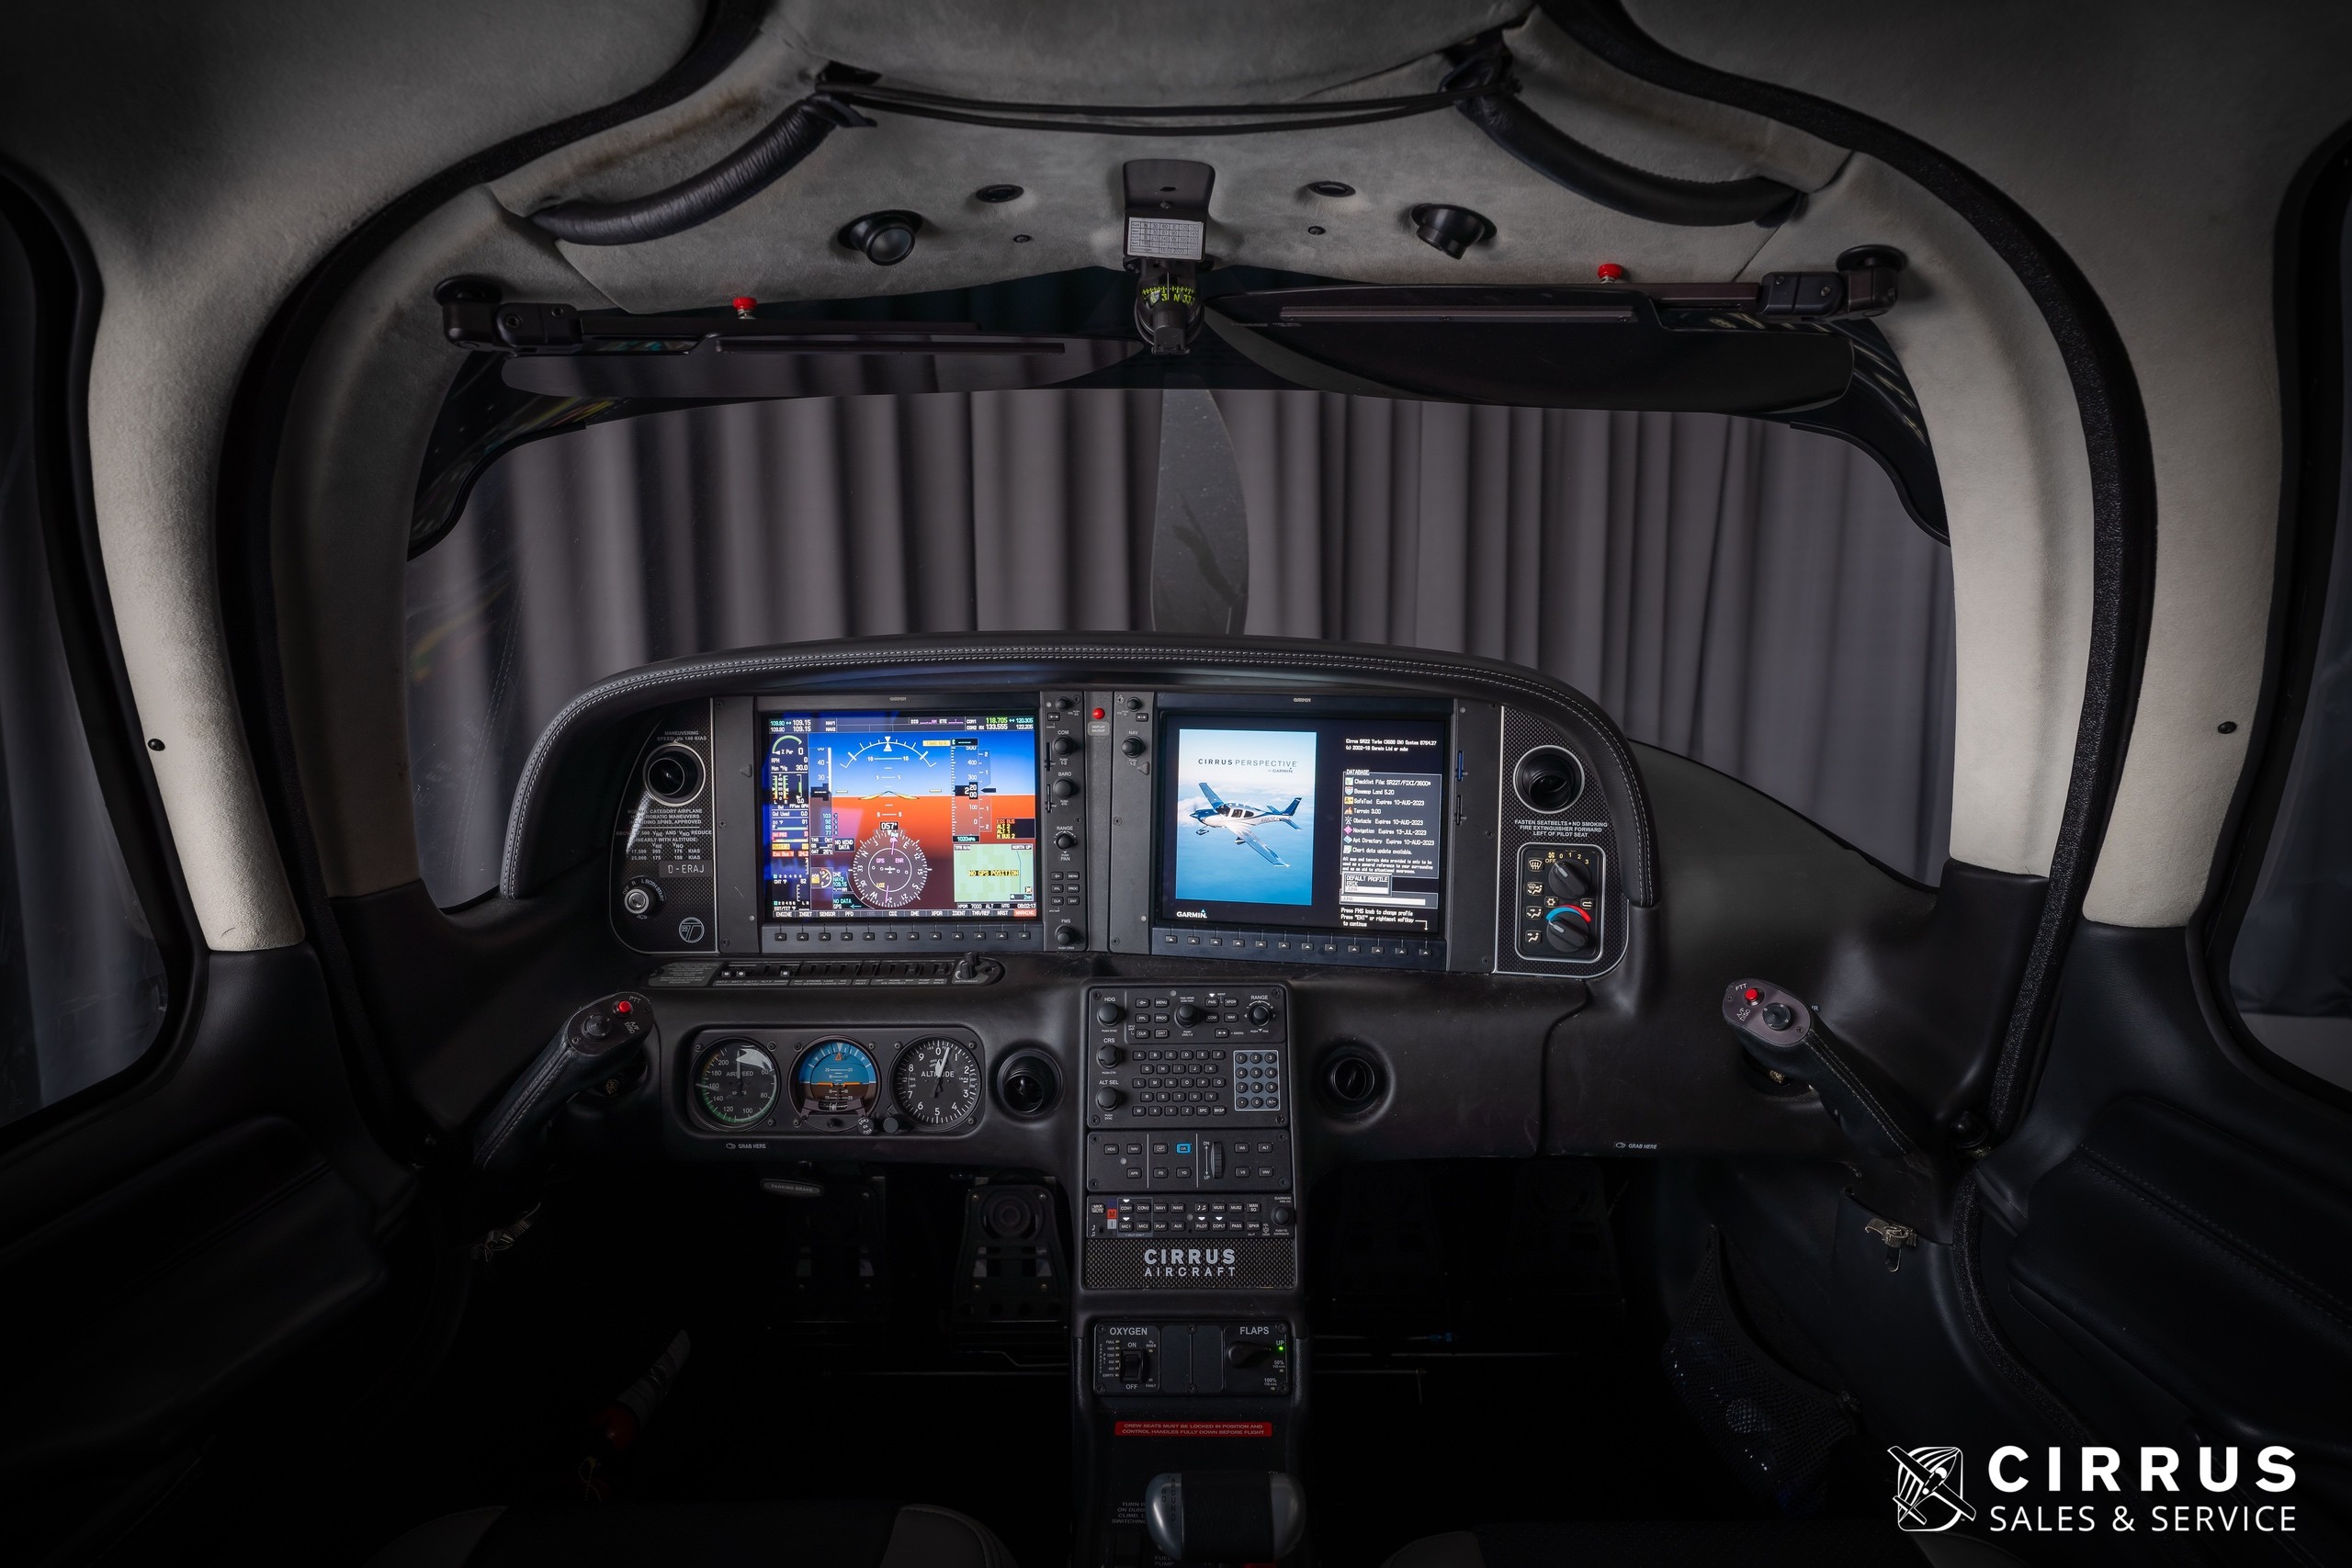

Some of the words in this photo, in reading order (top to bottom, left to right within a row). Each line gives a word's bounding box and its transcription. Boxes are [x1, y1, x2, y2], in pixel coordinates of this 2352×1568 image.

[645, 879, 657, 890] BOTH
[1735, 983, 1747, 991] PTT
[919, 1053, 925, 1061] 9
[908, 1064, 914, 1072] 8
[964, 1066, 970, 1074] 2
[908, 1091, 913, 1099] 7
[963, 1089, 969, 1098] 3
[917, 1102, 924, 1110] 6
[951, 1102, 957, 1110] 4
[935, 1108, 940, 1116] 5
[1144, 1249, 1235, 1265] CIRRUS
[1144, 1267, 1235, 1277] AIRCRAFT
[1110, 1327, 1147, 1335] OXYGEN
[1240, 1327, 1269, 1335] FLAPS
